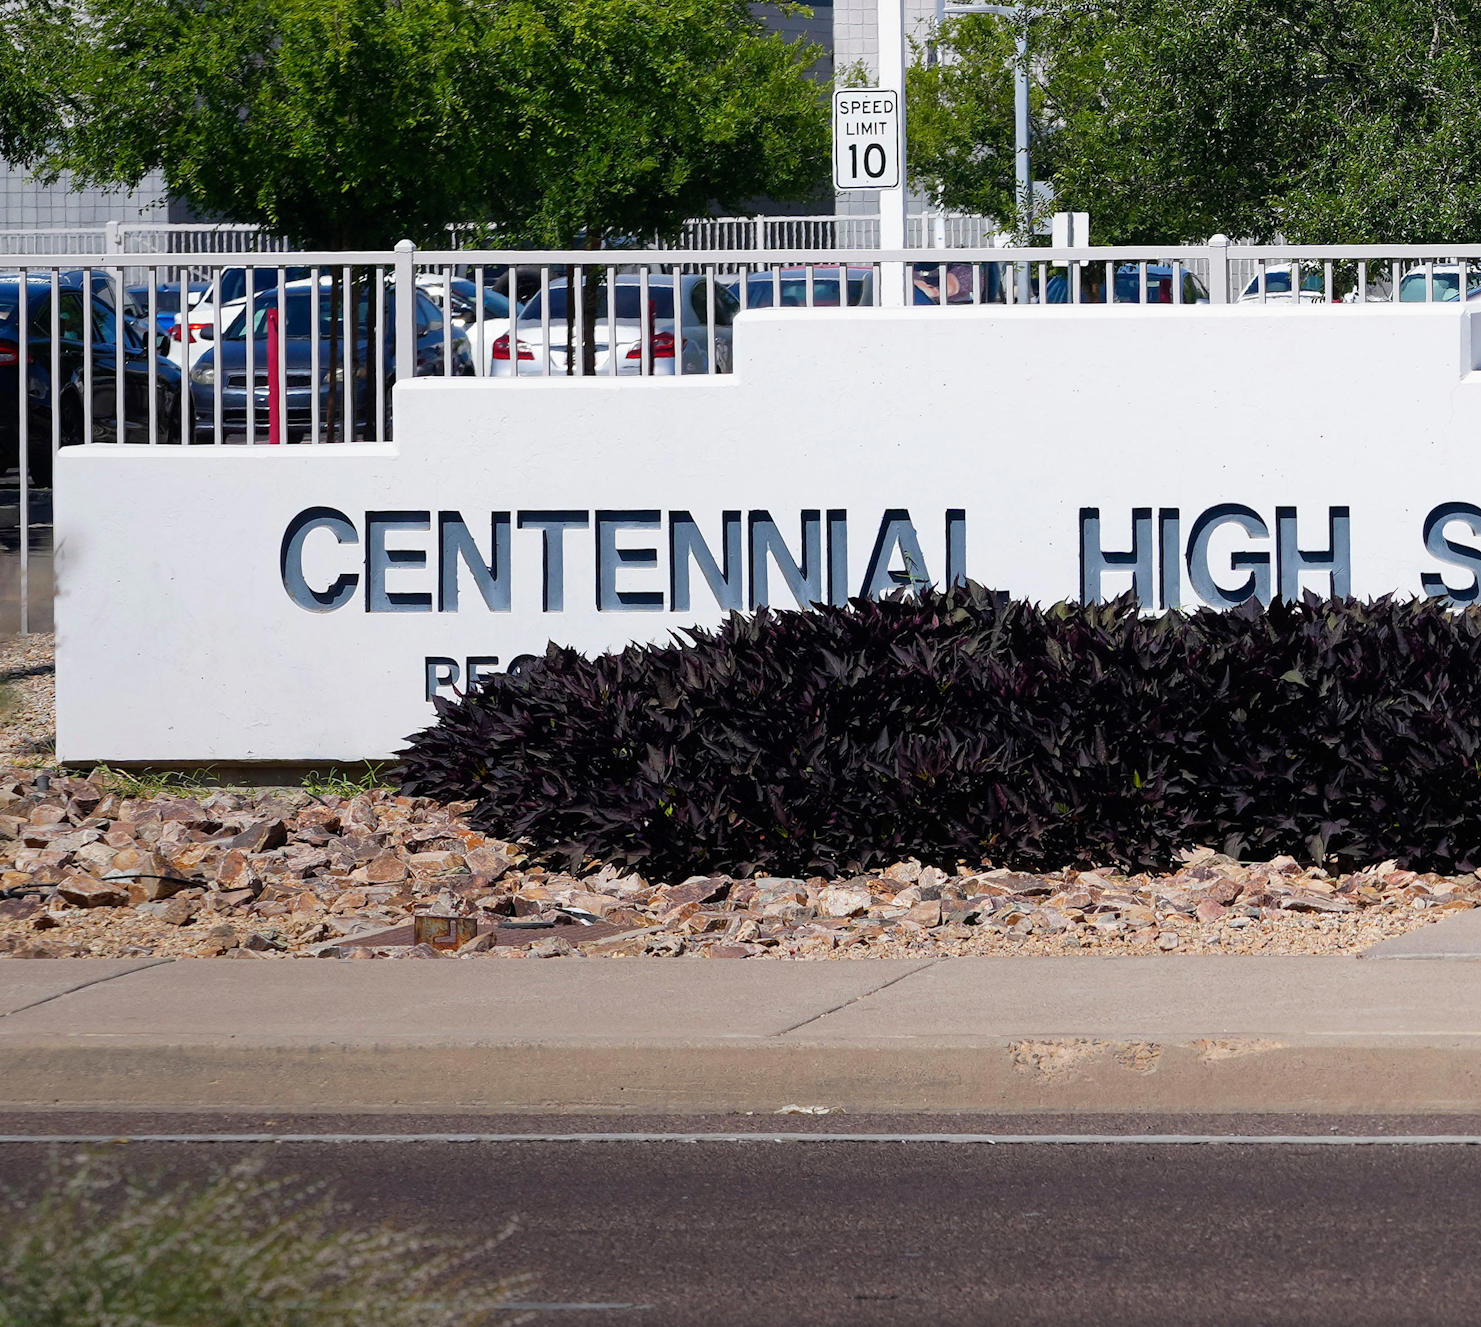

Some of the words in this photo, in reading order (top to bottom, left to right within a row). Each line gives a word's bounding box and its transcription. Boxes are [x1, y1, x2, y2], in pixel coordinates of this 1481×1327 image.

[840, 100, 894, 115] SPEED
[846, 121, 887, 136] LIMIT
[848, 143, 887, 179] 10
[280, 505, 1009, 614] CENTENNIAL
[1078, 502, 1351, 612] HIGH
